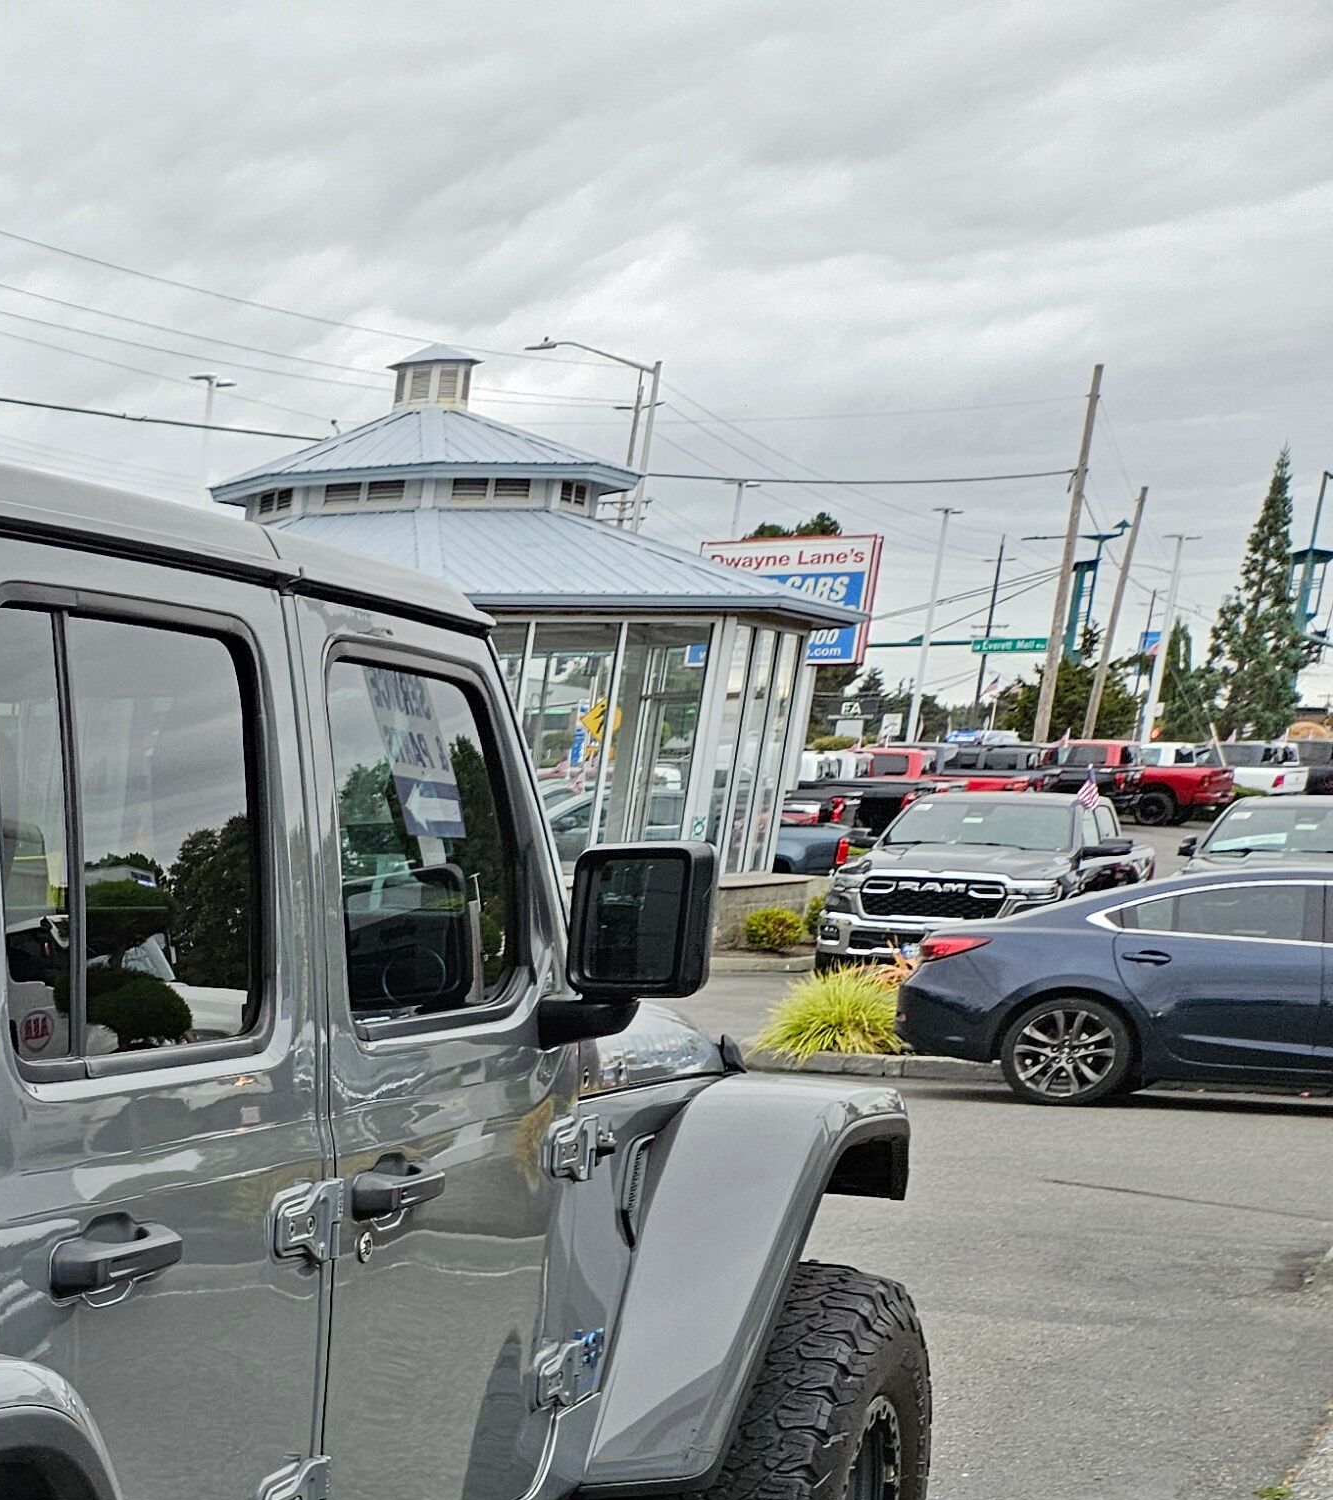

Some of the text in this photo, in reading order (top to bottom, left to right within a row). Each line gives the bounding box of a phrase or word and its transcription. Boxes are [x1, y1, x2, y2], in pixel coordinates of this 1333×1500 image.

[797, 548, 865, 565] Lane's
[784, 575, 851, 601] CARS
[981, 639, 1013, 651] Everett
[1016, 639, 1036, 650] Mall
[897, 881, 967, 893] RAM
